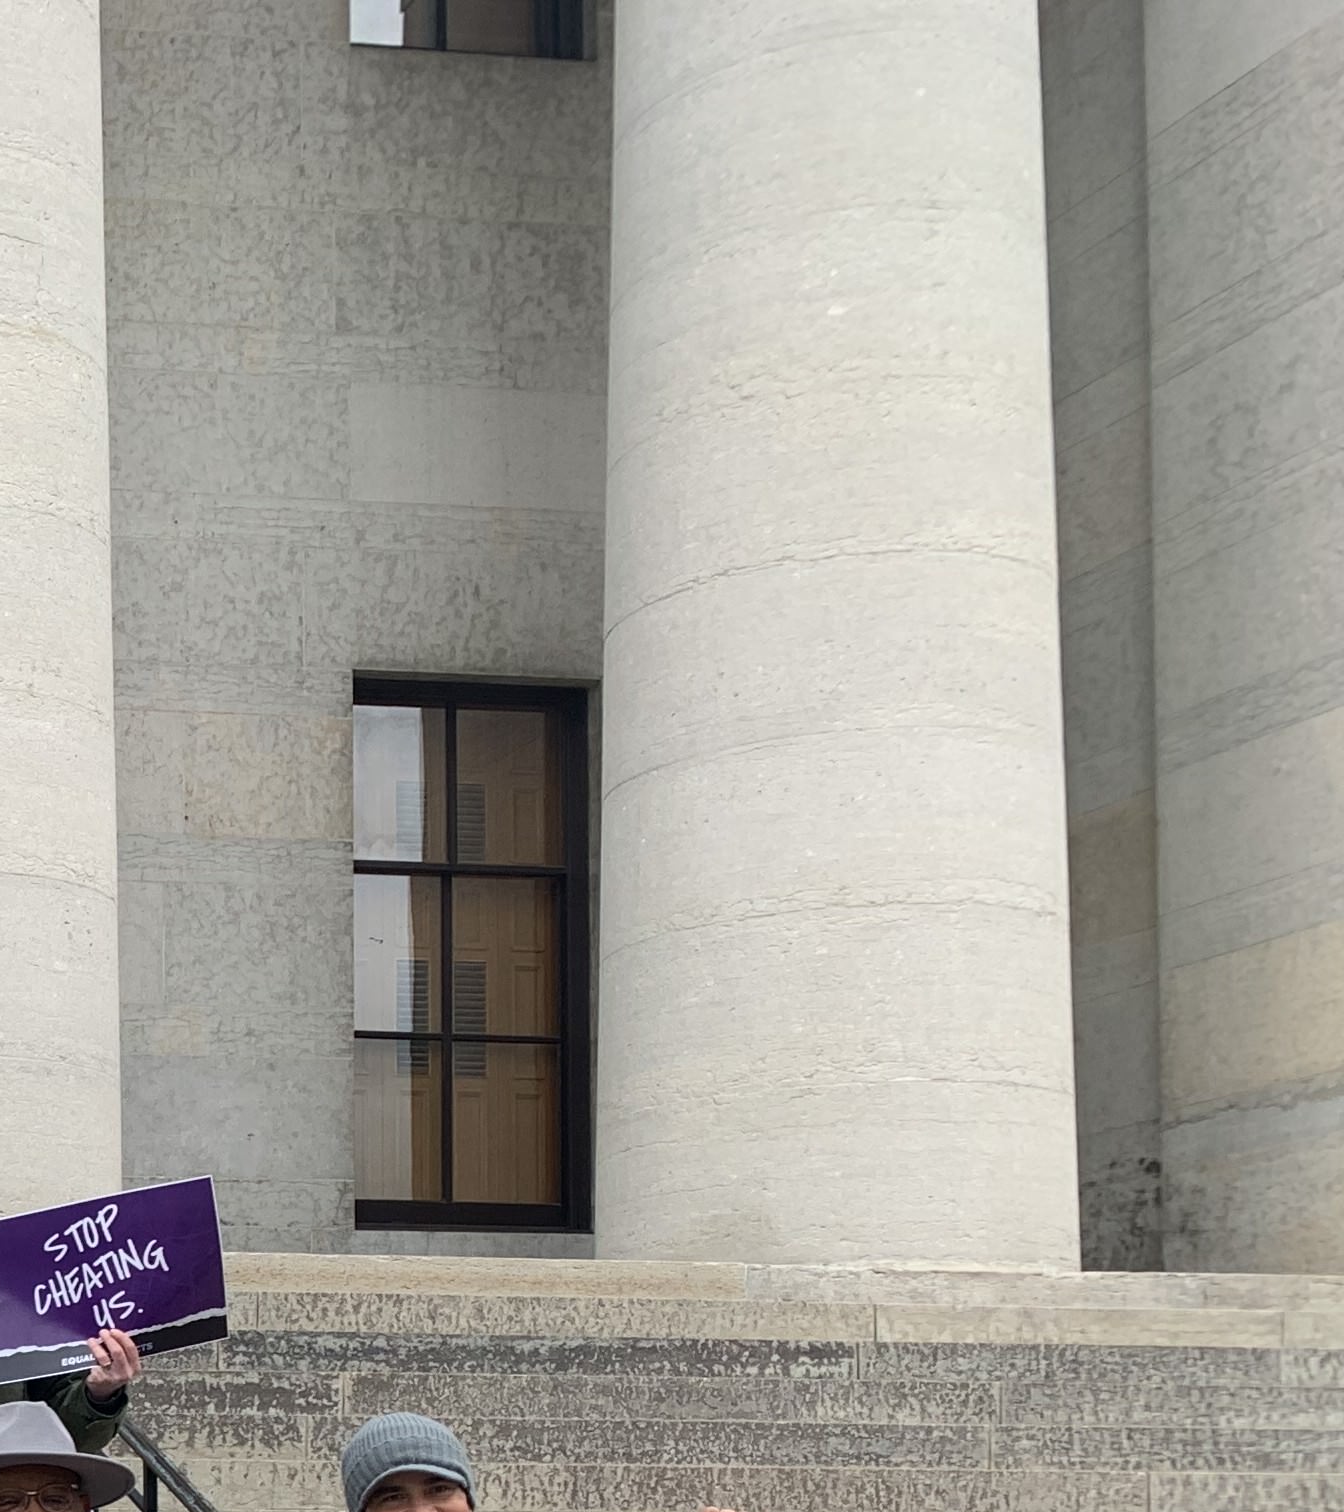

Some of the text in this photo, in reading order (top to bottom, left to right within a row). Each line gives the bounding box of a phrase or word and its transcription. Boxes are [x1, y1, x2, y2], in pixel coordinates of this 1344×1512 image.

[44, 1204, 118, 1262] STOP
[34, 1239, 169, 1315] CHEATING
[93, 1291, 143, 1329] US.
[61, 1353, 95, 1366] EQUAL
